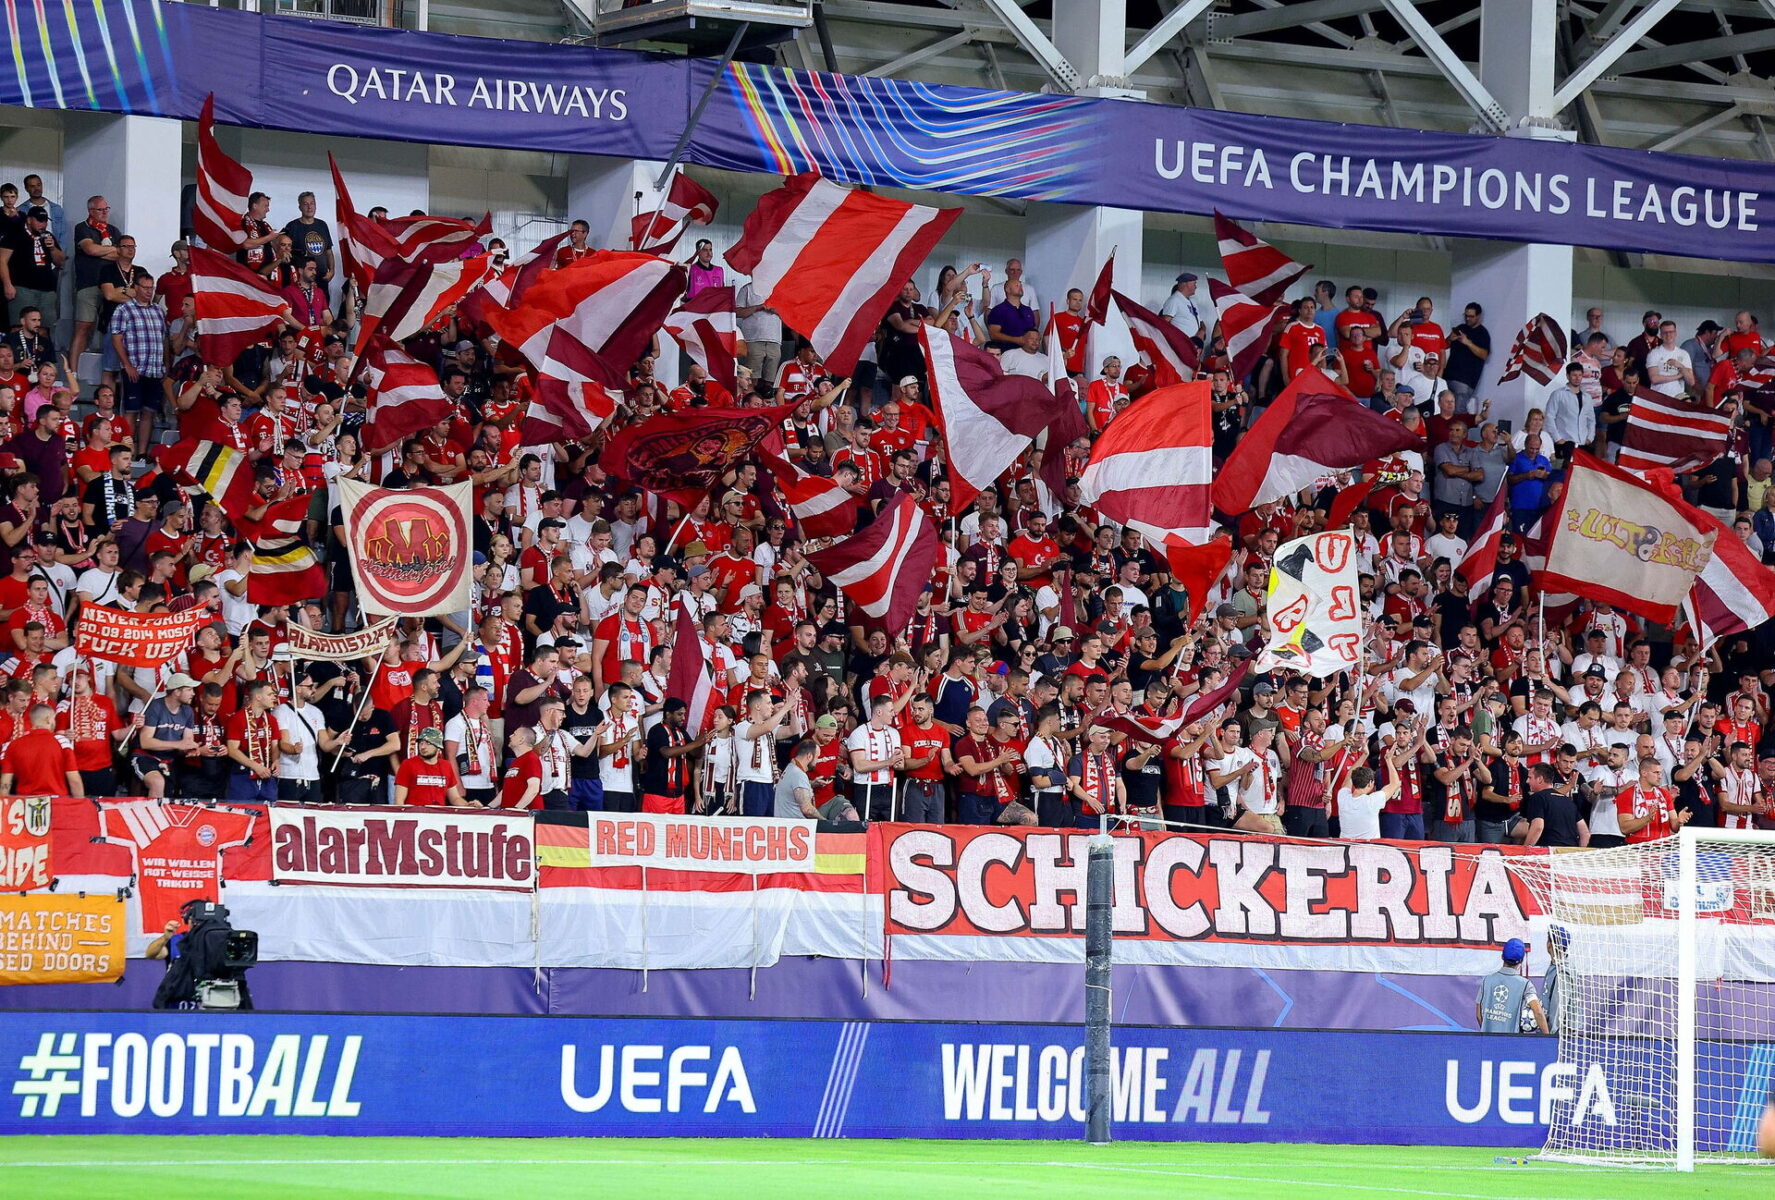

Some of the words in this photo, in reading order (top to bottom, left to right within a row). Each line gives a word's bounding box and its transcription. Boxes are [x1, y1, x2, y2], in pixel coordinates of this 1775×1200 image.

[327, 63, 457, 106] QATAR
[469, 77, 628, 122] AIRWAYS
[1155, 138, 1274, 190] UEFA
[1290, 152, 1570, 216] CHAMPIONS
[1586, 177, 1760, 232] LEAGUE
[81, 607, 139, 627] NEVER
[142, 607, 206, 628] FORGET
[77, 633, 139, 659] FUCK
[275, 816, 531, 882] alarMstufe
[596, 819, 655, 857] RED
[142, 858, 166, 867] WIR
[167, 859, 216, 869] WOLLEN
[143, 868, 215, 879] ROT-WEISSE
[156, 879, 204, 889] TRIKOTS
[888, 828, 1530, 948] SCHICKERIA
[0, 910, 113, 934] MATCHES
[42, 952, 110, 973] DOORS
[12, 1031, 363, 1119] #FOOTBALL
[560, 1044, 757, 1114] UEFA
[941, 1043, 1169, 1122] WELCOME
[1172, 1047, 1272, 1124] ALL
[1445, 1059, 1618, 1126] UEFA
